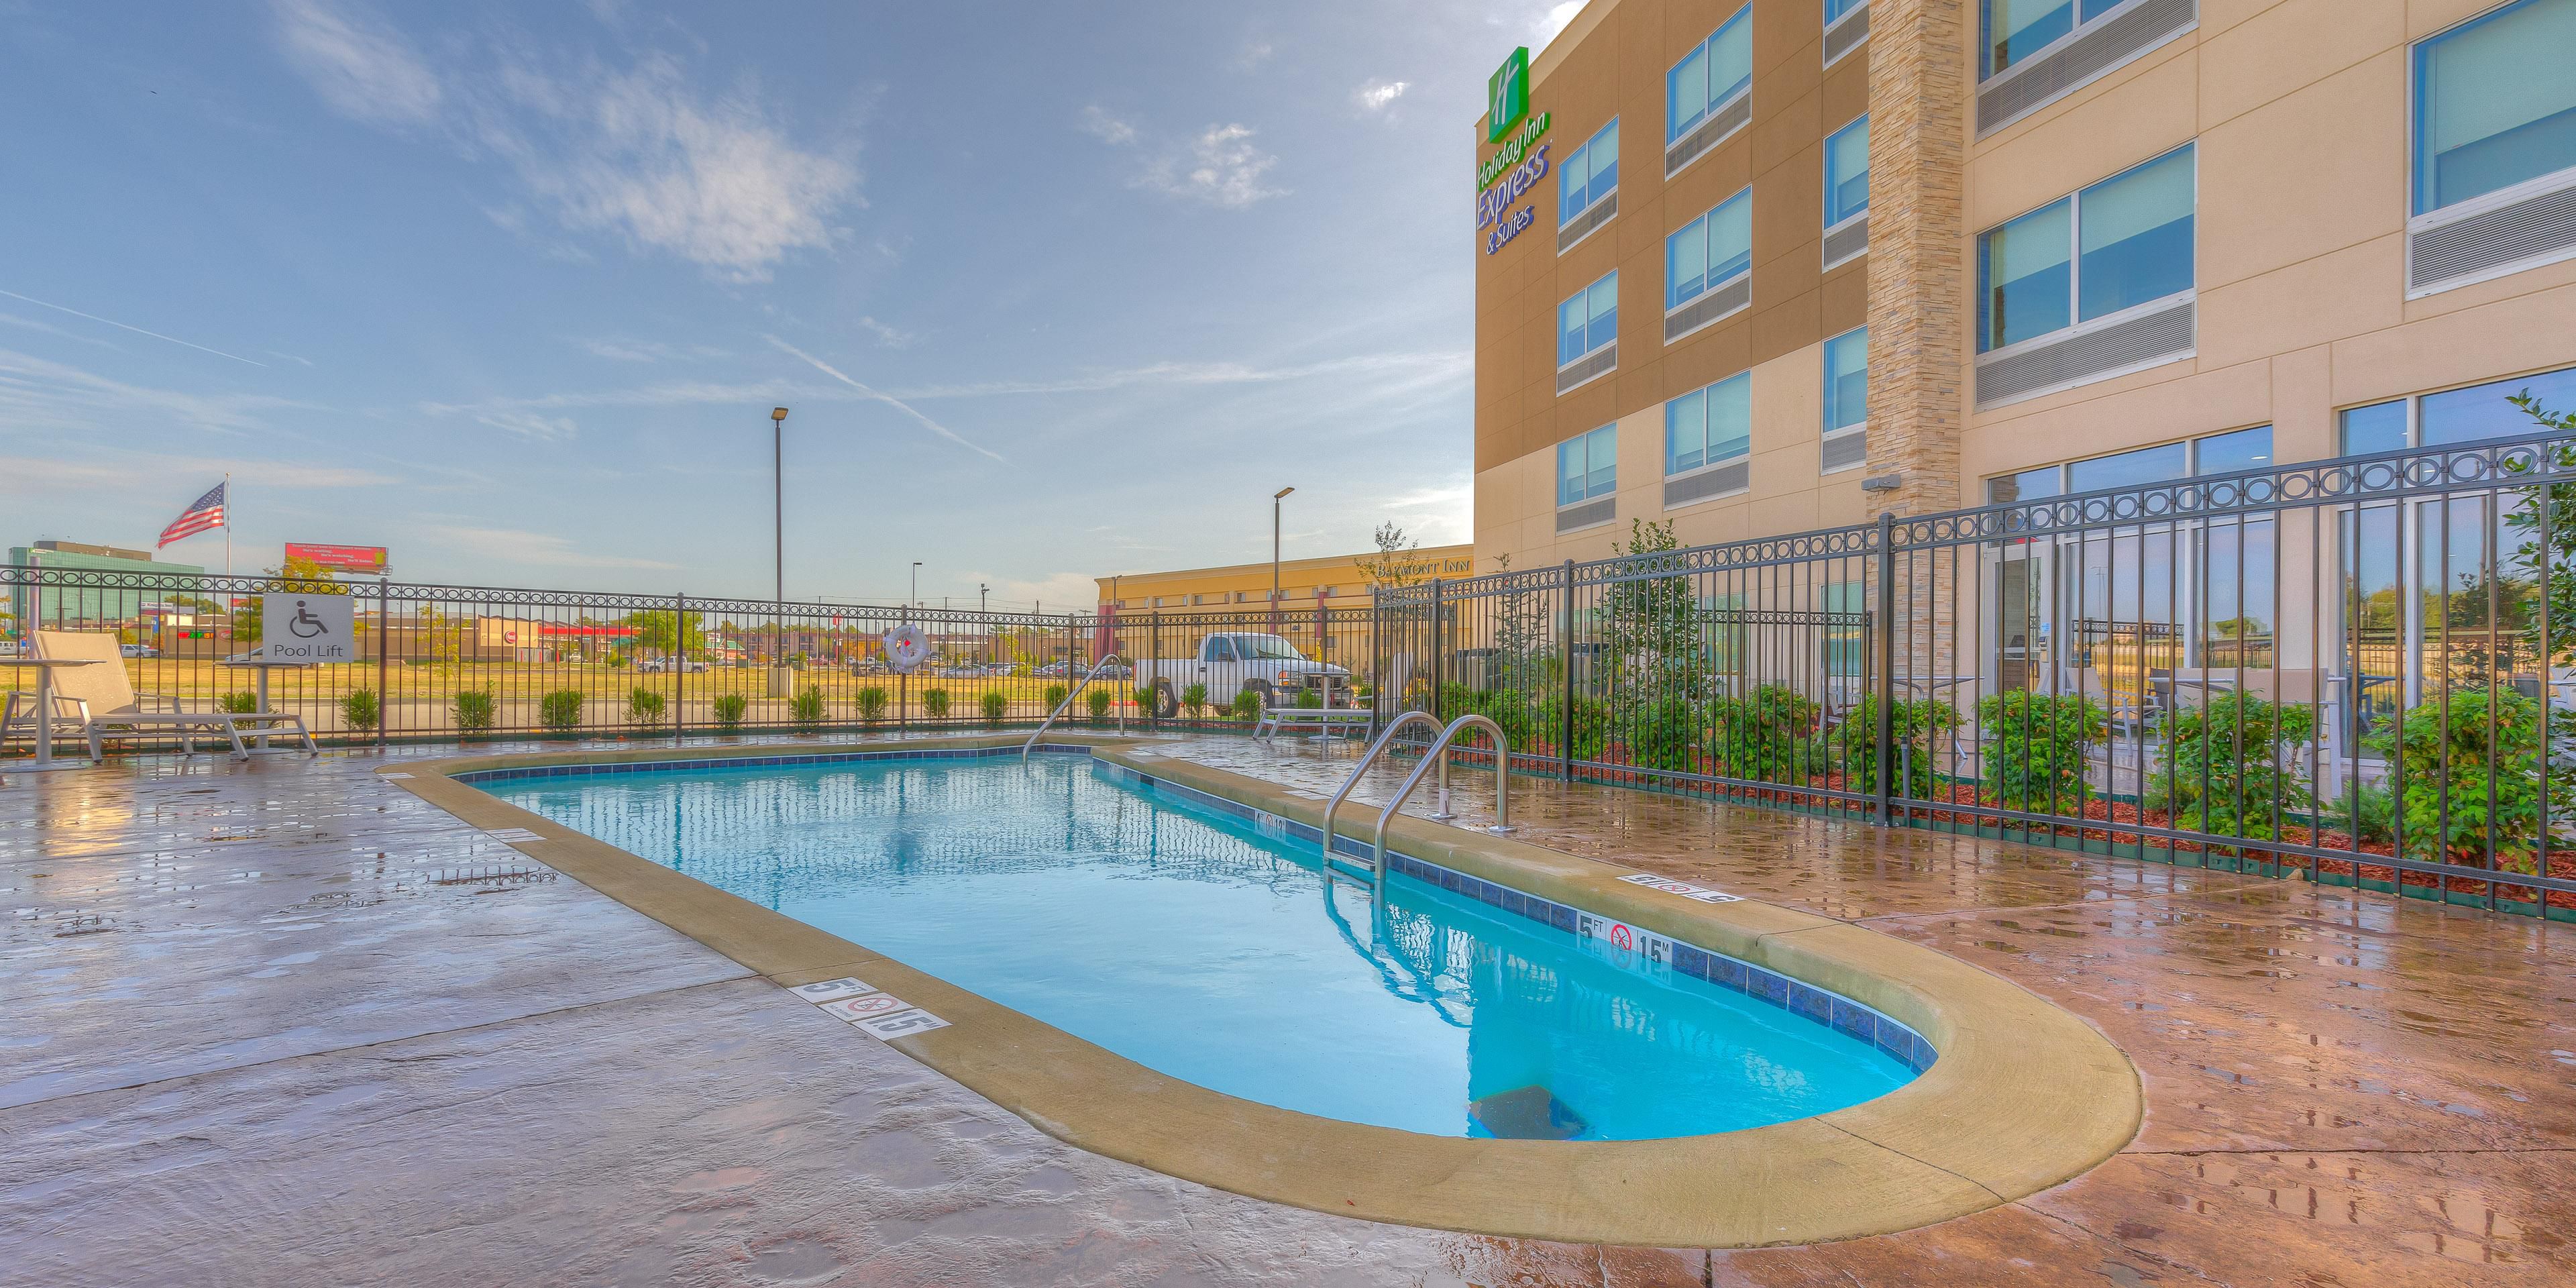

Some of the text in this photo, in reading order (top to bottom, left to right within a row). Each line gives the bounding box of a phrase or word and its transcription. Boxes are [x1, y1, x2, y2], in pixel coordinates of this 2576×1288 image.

[1477, 111, 1548, 191] Holiday Inn
[1476, 144, 1549, 230] Express
[1486, 205, 1534, 256] & Suites
[274, 644, 343, 657] Pool Lift
[1580, 914, 1593, 939] 5
[1593, 920, 1603, 932] FT
[1662, 942, 1669, 953] M
[802, 979, 856, 993] 5
